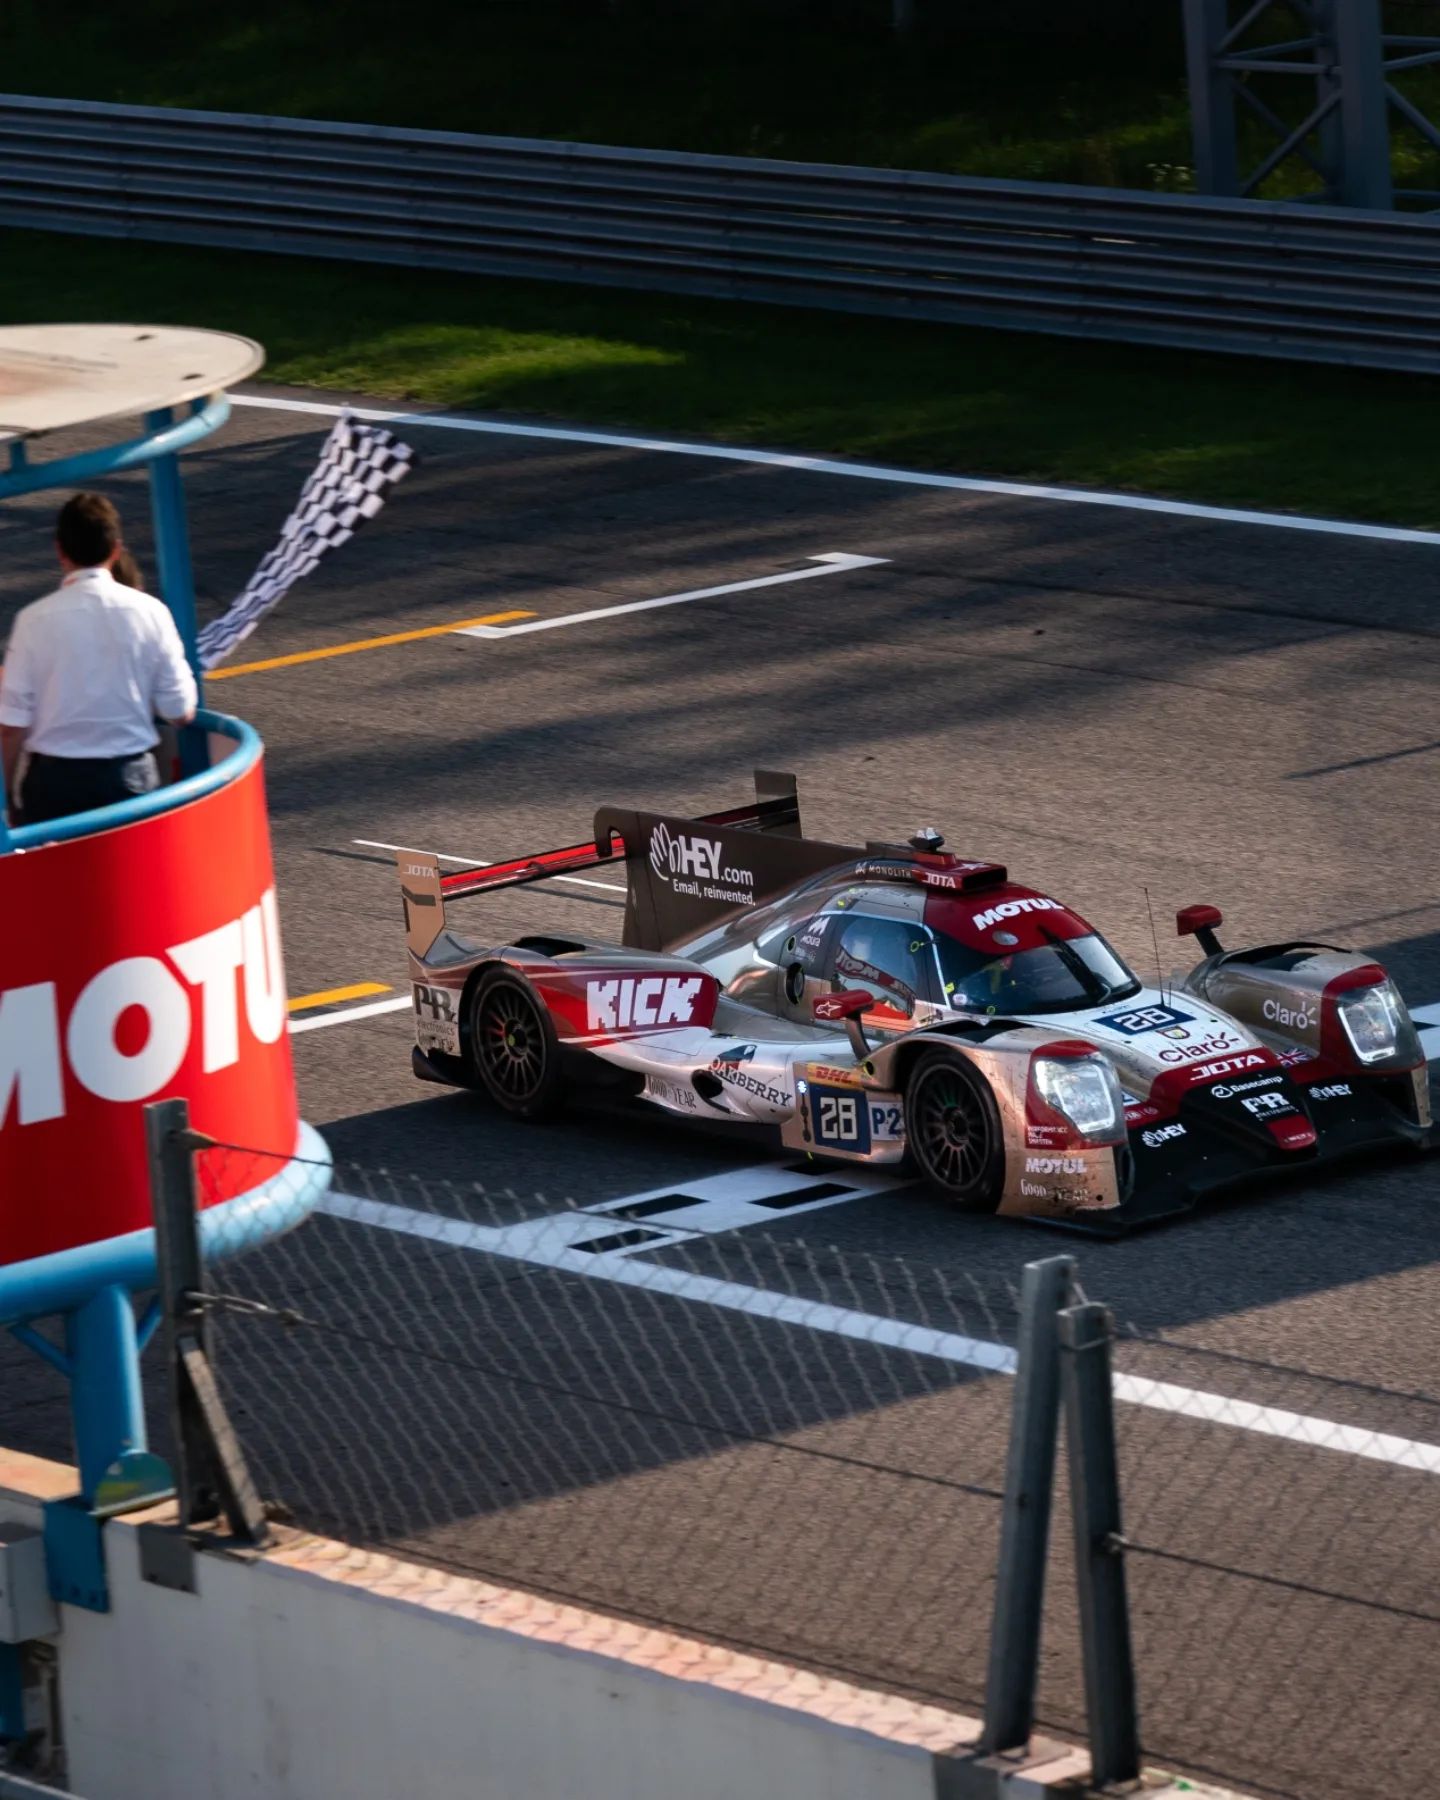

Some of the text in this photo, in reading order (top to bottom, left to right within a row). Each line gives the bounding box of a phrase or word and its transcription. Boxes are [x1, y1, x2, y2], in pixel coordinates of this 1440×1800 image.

[402, 863, 436, 879] JOTA
[868, 864, 912, 879] MONOLITH
[922, 871, 957, 889] JOTA
[673, 879, 756, 907] Email, reinvented.
[972, 897, 1065, 931] MOTUL
[587, 977, 703, 1030] KICK
[1263, 999, 1310, 1030] Claro
[1112, 1007, 1177, 1032] 28
[1158, 1036, 1230, 1064] Claro
[815, 1065, 853, 1084] DHL
[1190, 1054, 1267, 1081] JOTA
[708, 1056, 793, 1107] OAKBERRY
[1229, 1075, 1284, 1093] Basecamp
[820, 1096, 859, 1140] 28
[871, 1106, 901, 1135] P2
[1025, 1157, 1088, 1175] MOTUL
